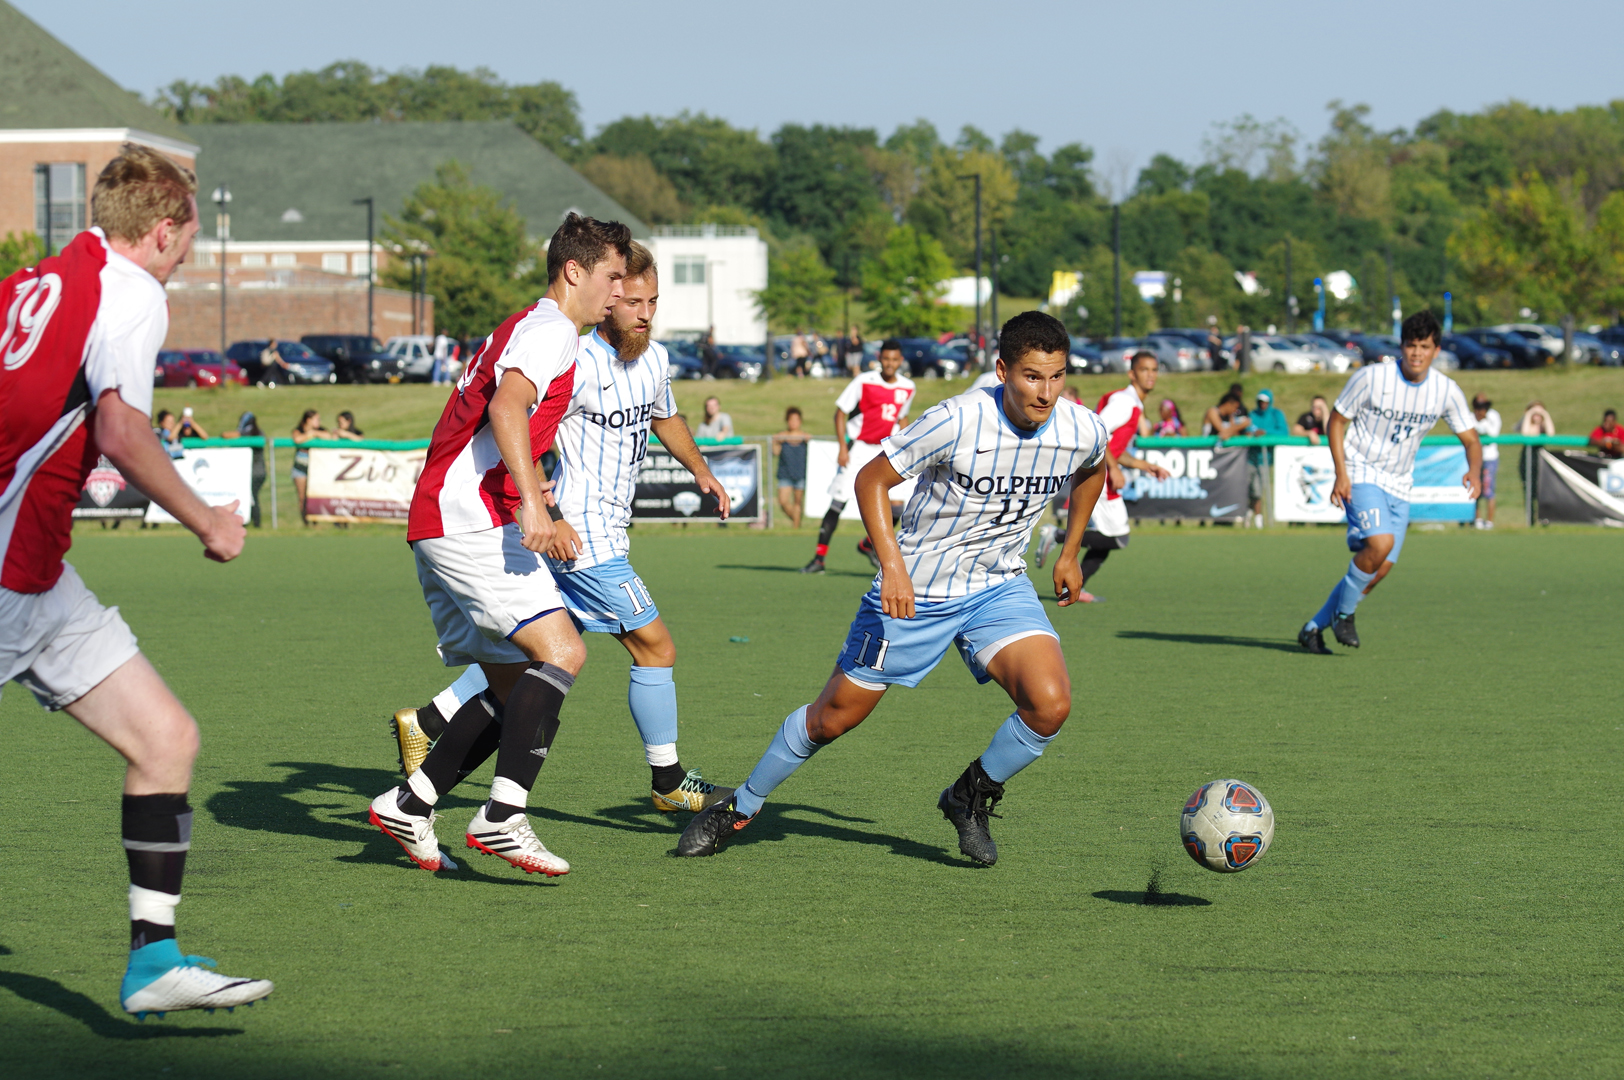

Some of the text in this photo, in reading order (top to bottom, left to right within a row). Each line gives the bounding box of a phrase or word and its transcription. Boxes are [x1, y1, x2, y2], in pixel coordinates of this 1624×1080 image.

[0, 272, 62, 371] 19
[881, 403, 897, 422] 12
[1390, 424, 1413, 444] 27
[334, 454, 400, 482] Zio
[990, 498, 1031, 526] 11
[1357, 508, 1381, 530] 27
[853, 630, 890, 672] 11
